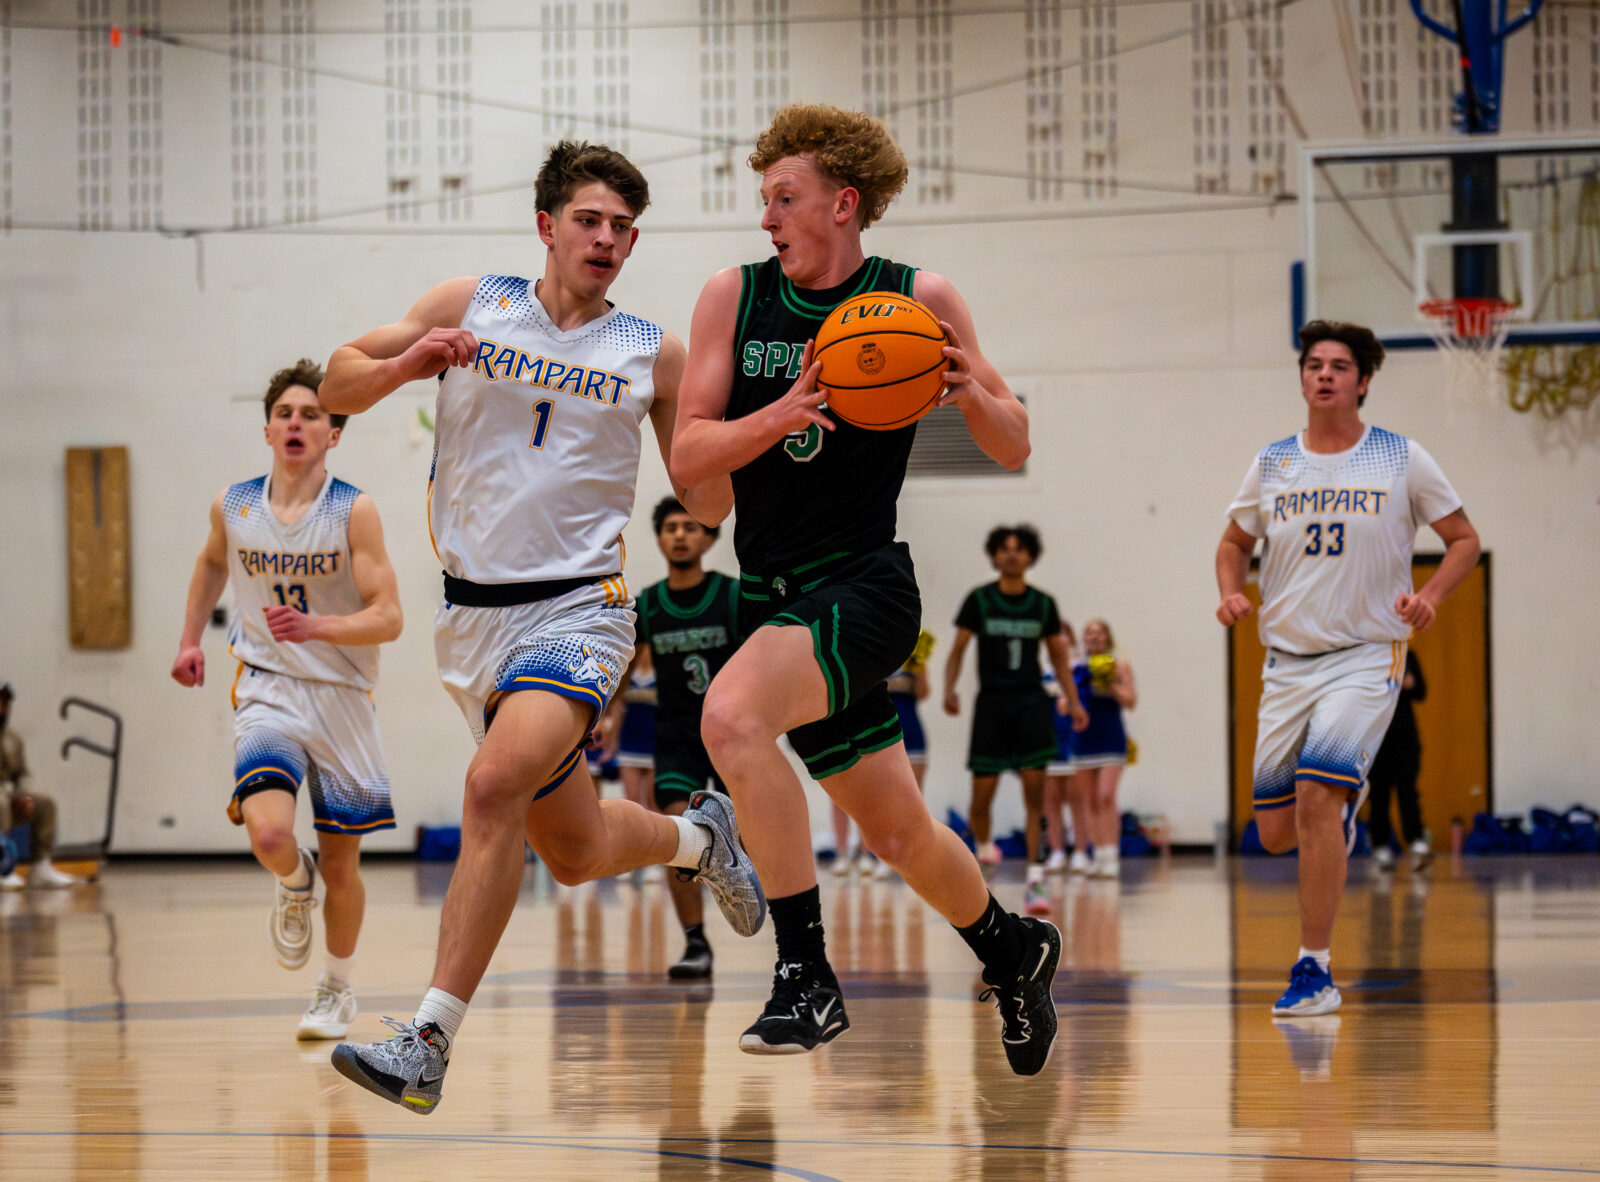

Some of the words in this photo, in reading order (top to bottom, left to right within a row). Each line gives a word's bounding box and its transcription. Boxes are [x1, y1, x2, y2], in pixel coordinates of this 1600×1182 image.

[840, 304, 896, 325] EVO
[472, 338, 631, 408] RAMPART
[743, 341, 807, 378] SPA
[529, 398, 555, 450] 1
[1273, 487, 1389, 522] RAMPART
[1304, 521, 1346, 558] 33
[237, 547, 342, 577] RAMPART
[272, 582, 309, 614] 13
[683, 653, 710, 694] 3
